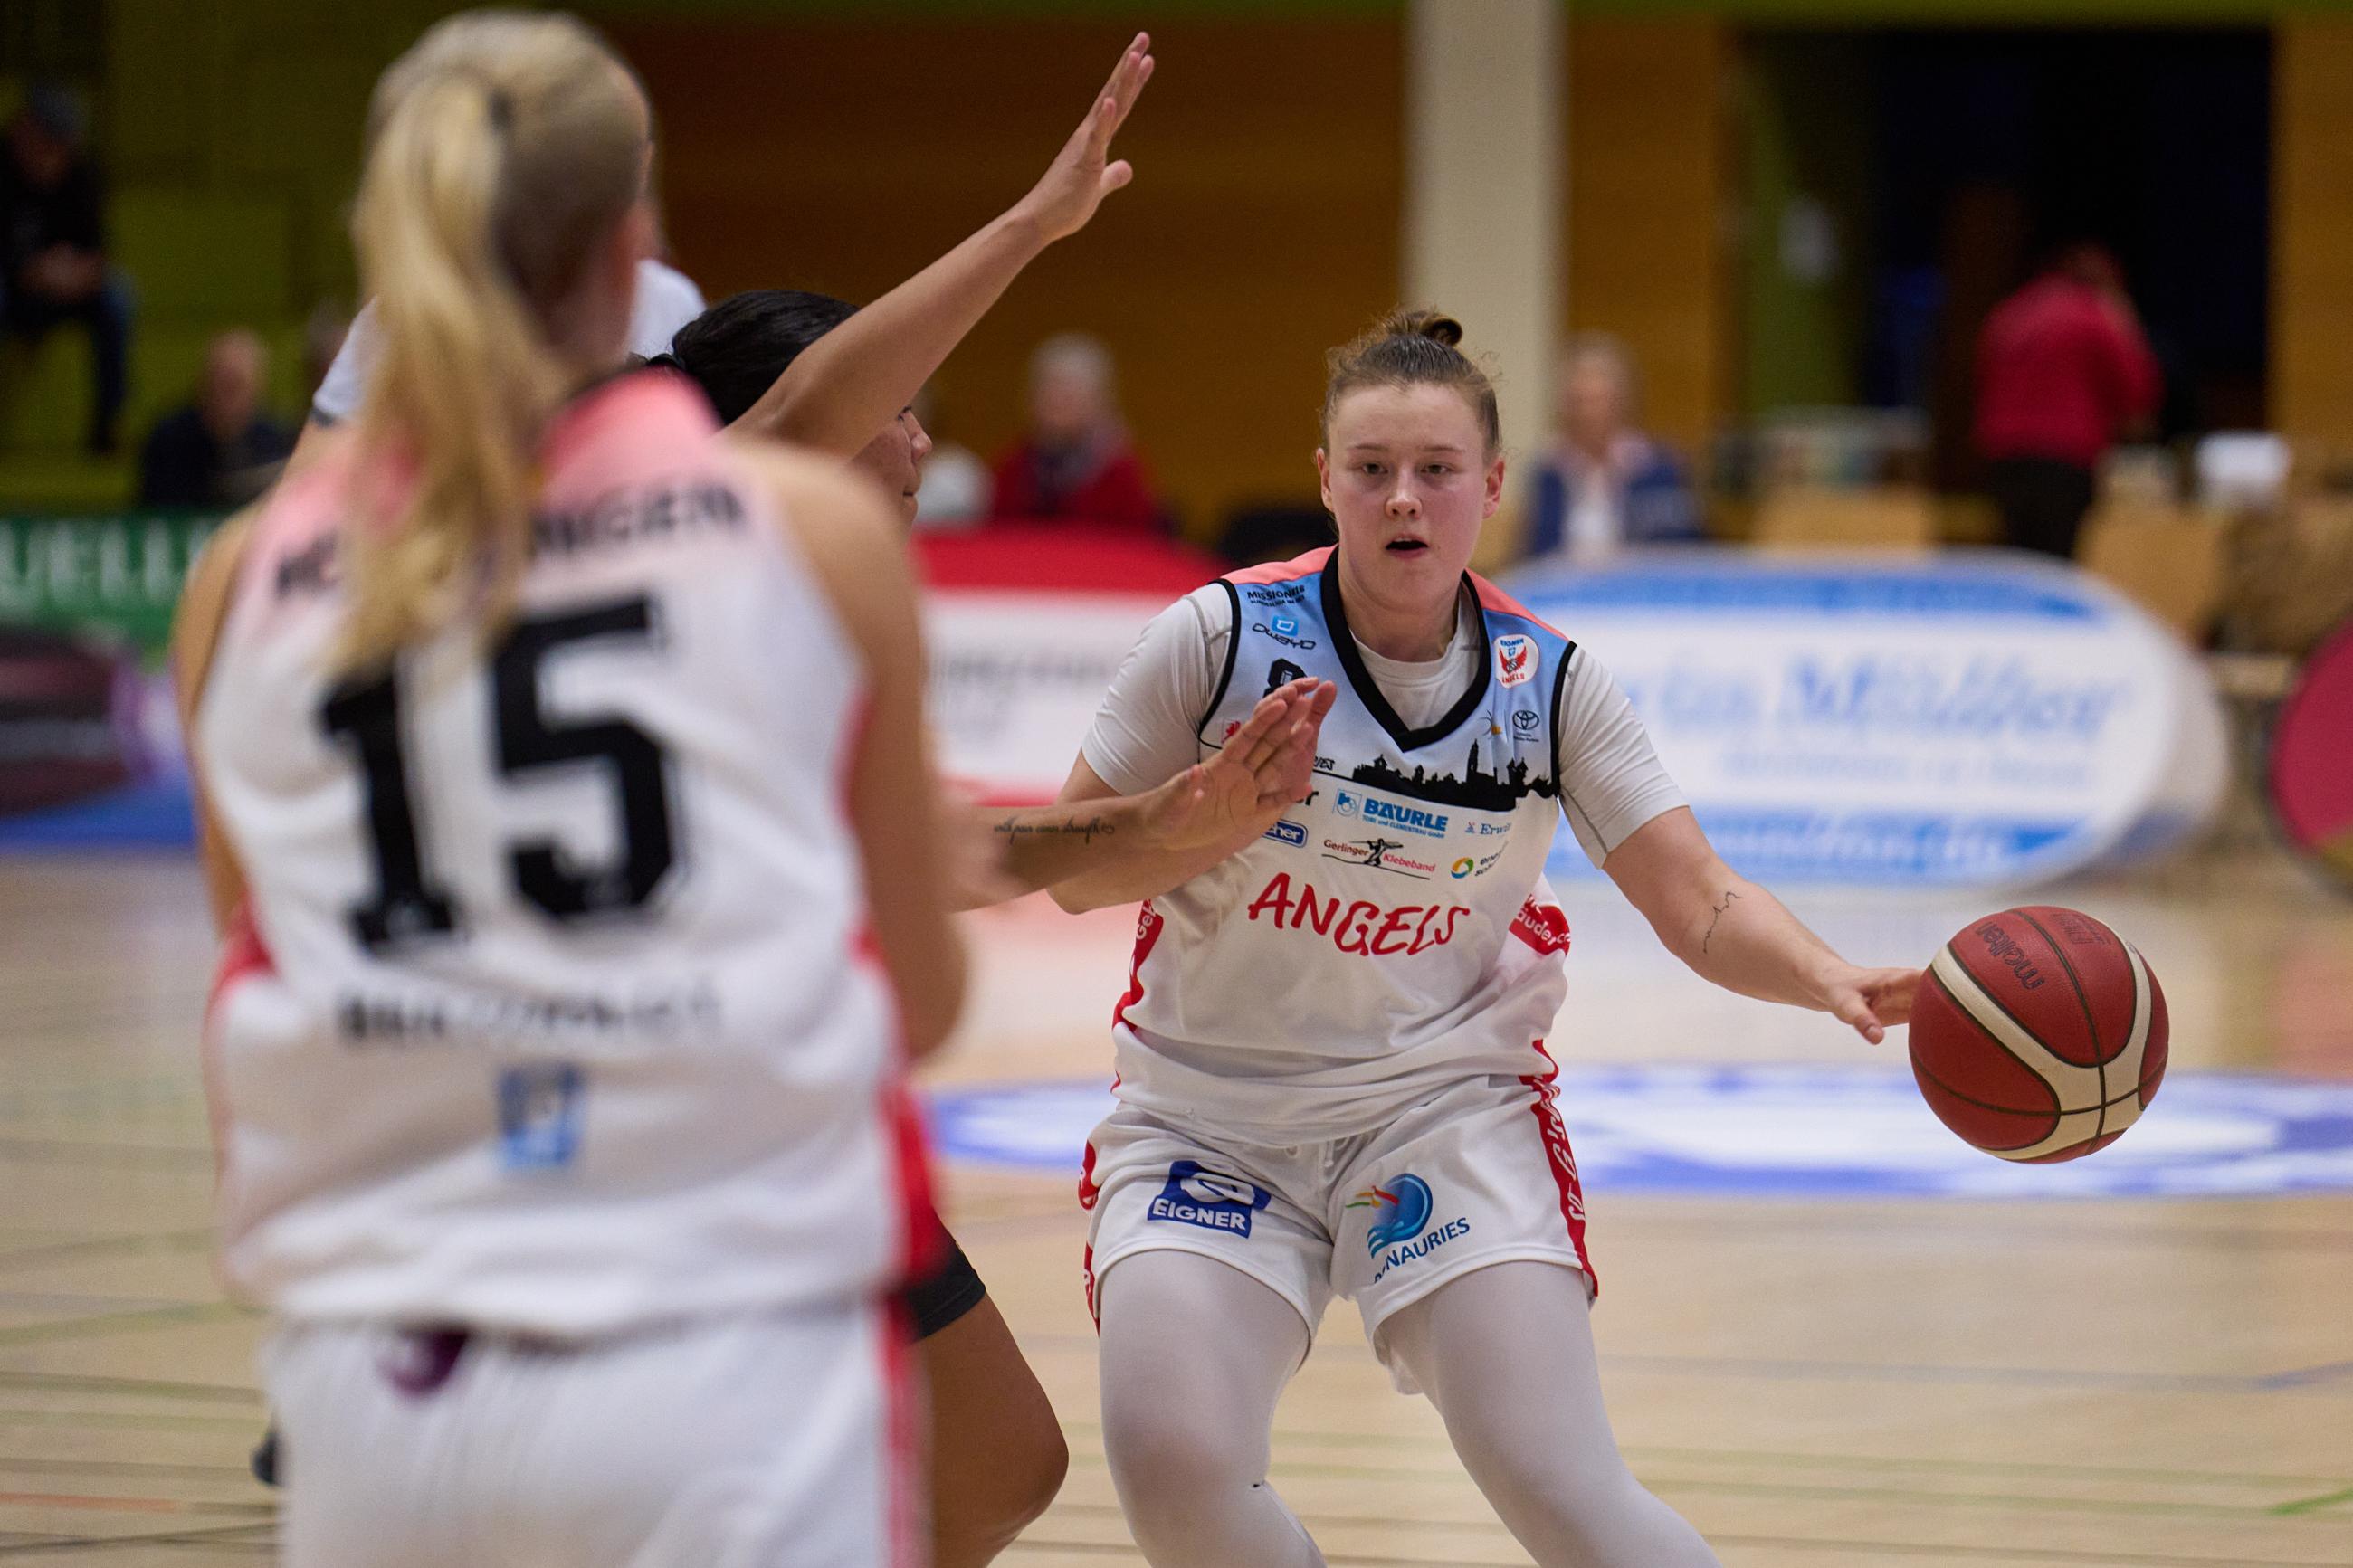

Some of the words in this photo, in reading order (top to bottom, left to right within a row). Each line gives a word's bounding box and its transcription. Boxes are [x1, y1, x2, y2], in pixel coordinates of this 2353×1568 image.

[318, 591, 686, 959] 15
[1363, 797, 1449, 832] BÄURLE
[1323, 838, 1370, 857] Gerlinger
[1383, 852, 1436, 873] Klebeband
[1247, 872, 1471, 956] ANGELS
[1975, 920, 2045, 990] molten
[1152, 1197, 1246, 1231] EIGNER
